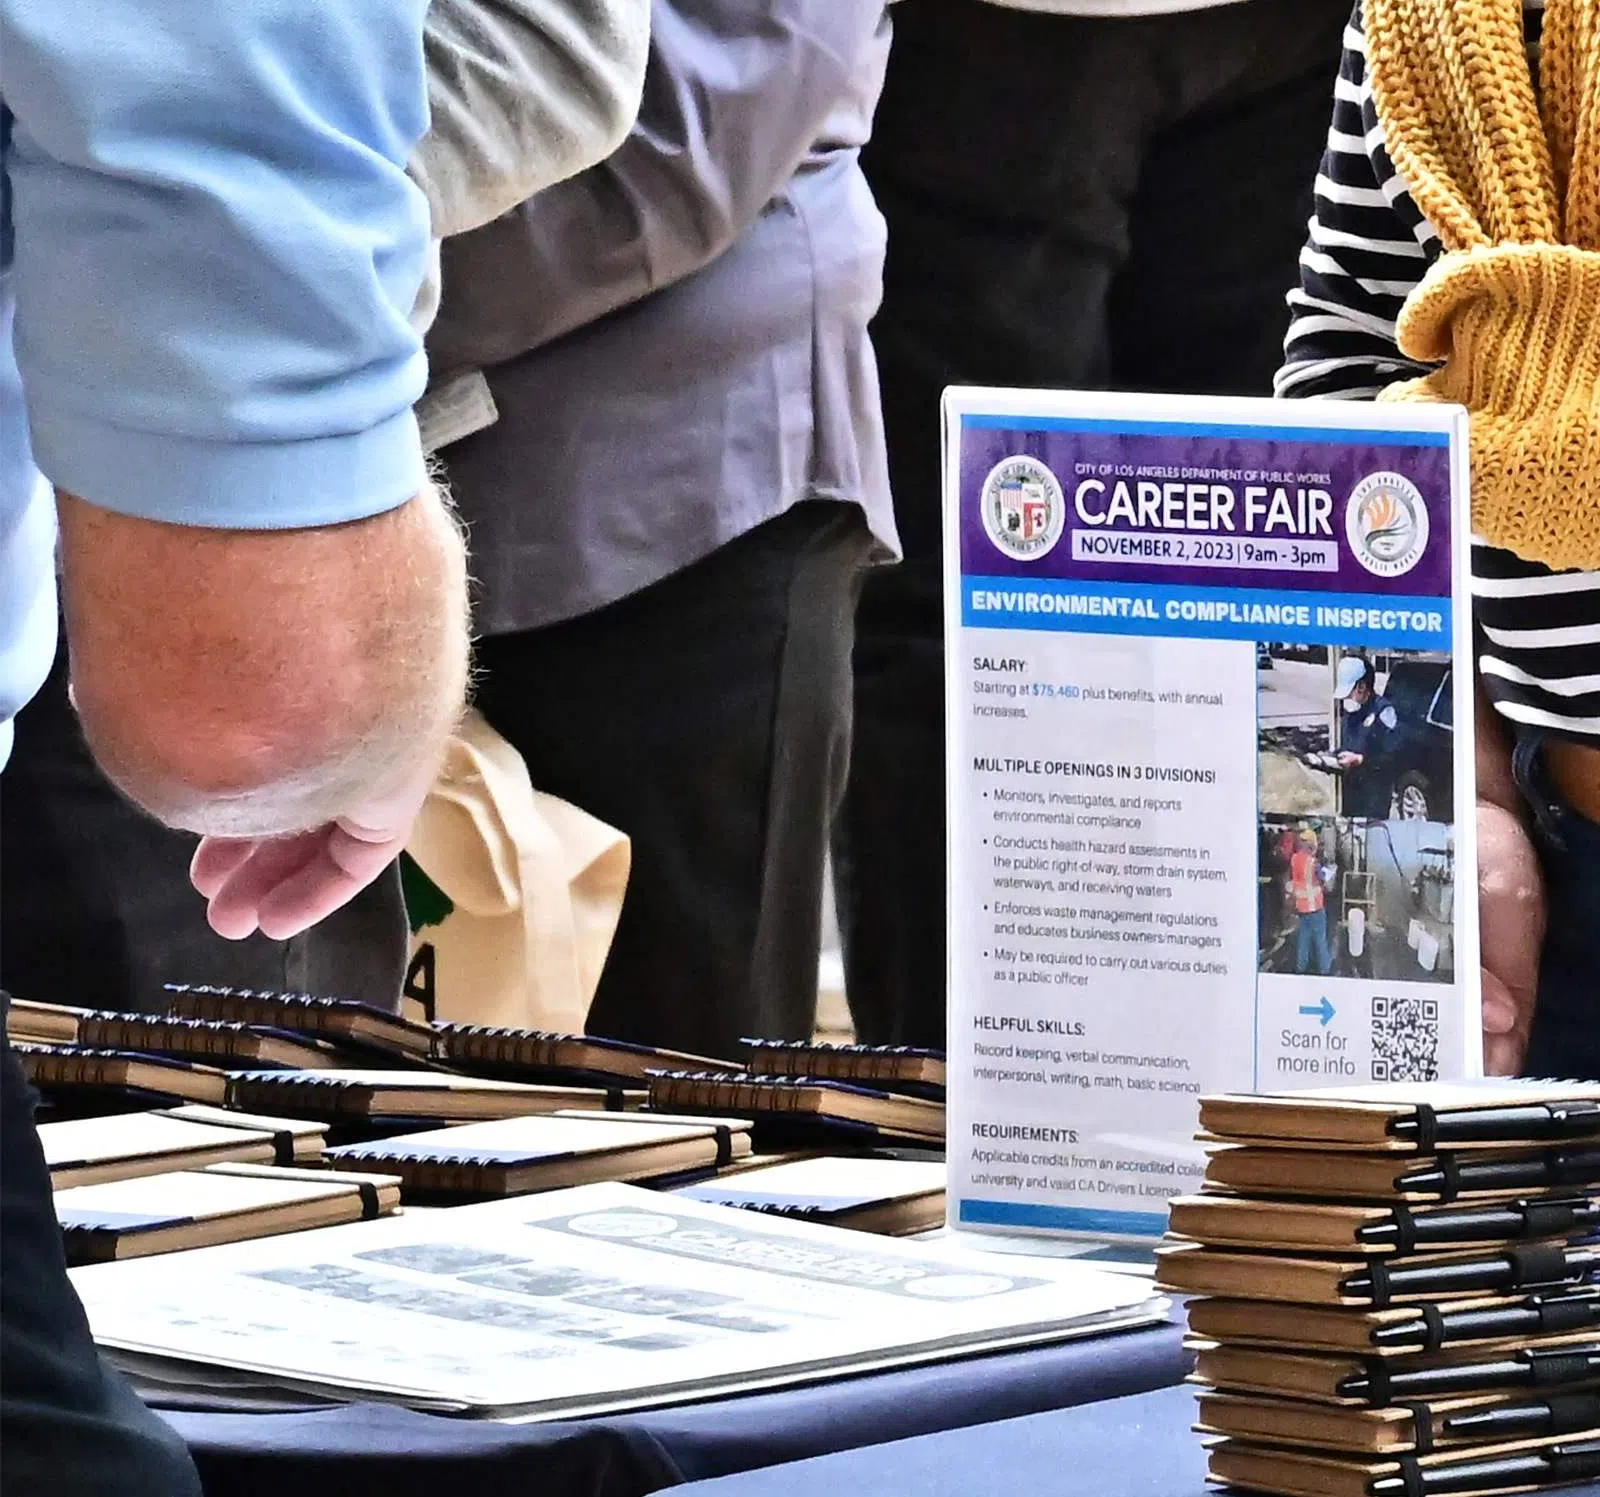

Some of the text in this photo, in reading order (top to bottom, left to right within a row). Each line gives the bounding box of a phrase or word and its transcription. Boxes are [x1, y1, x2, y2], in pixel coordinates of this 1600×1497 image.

[1075, 463, 1331, 484] CITY OF LOS ANGELES DEPARTMENT OF PUBLIC WORKS
[1075, 479, 1235, 531] CAREER
[1245, 487, 1333, 535] FAIR
[1082, 537, 1171, 557] NOVEMBER
[1177, 541, 1189, 561] 2,
[1194, 541, 1233, 560] 2023
[1244, 544, 1277, 562] 9am
[1291, 546, 1325, 567] 3pm
[972, 591, 1442, 632] ENVIRONMENTAL COMPLIANCE INSPECTOR
[974, 758, 1215, 783] MULTIPLE OPENINGS IN 3 DIVISIONS!
[974, 1016, 1085, 1036] HELPFUL SKILLS:
[1281, 1030, 1348, 1050] Scan for
[1277, 1056, 1355, 1075] more info
